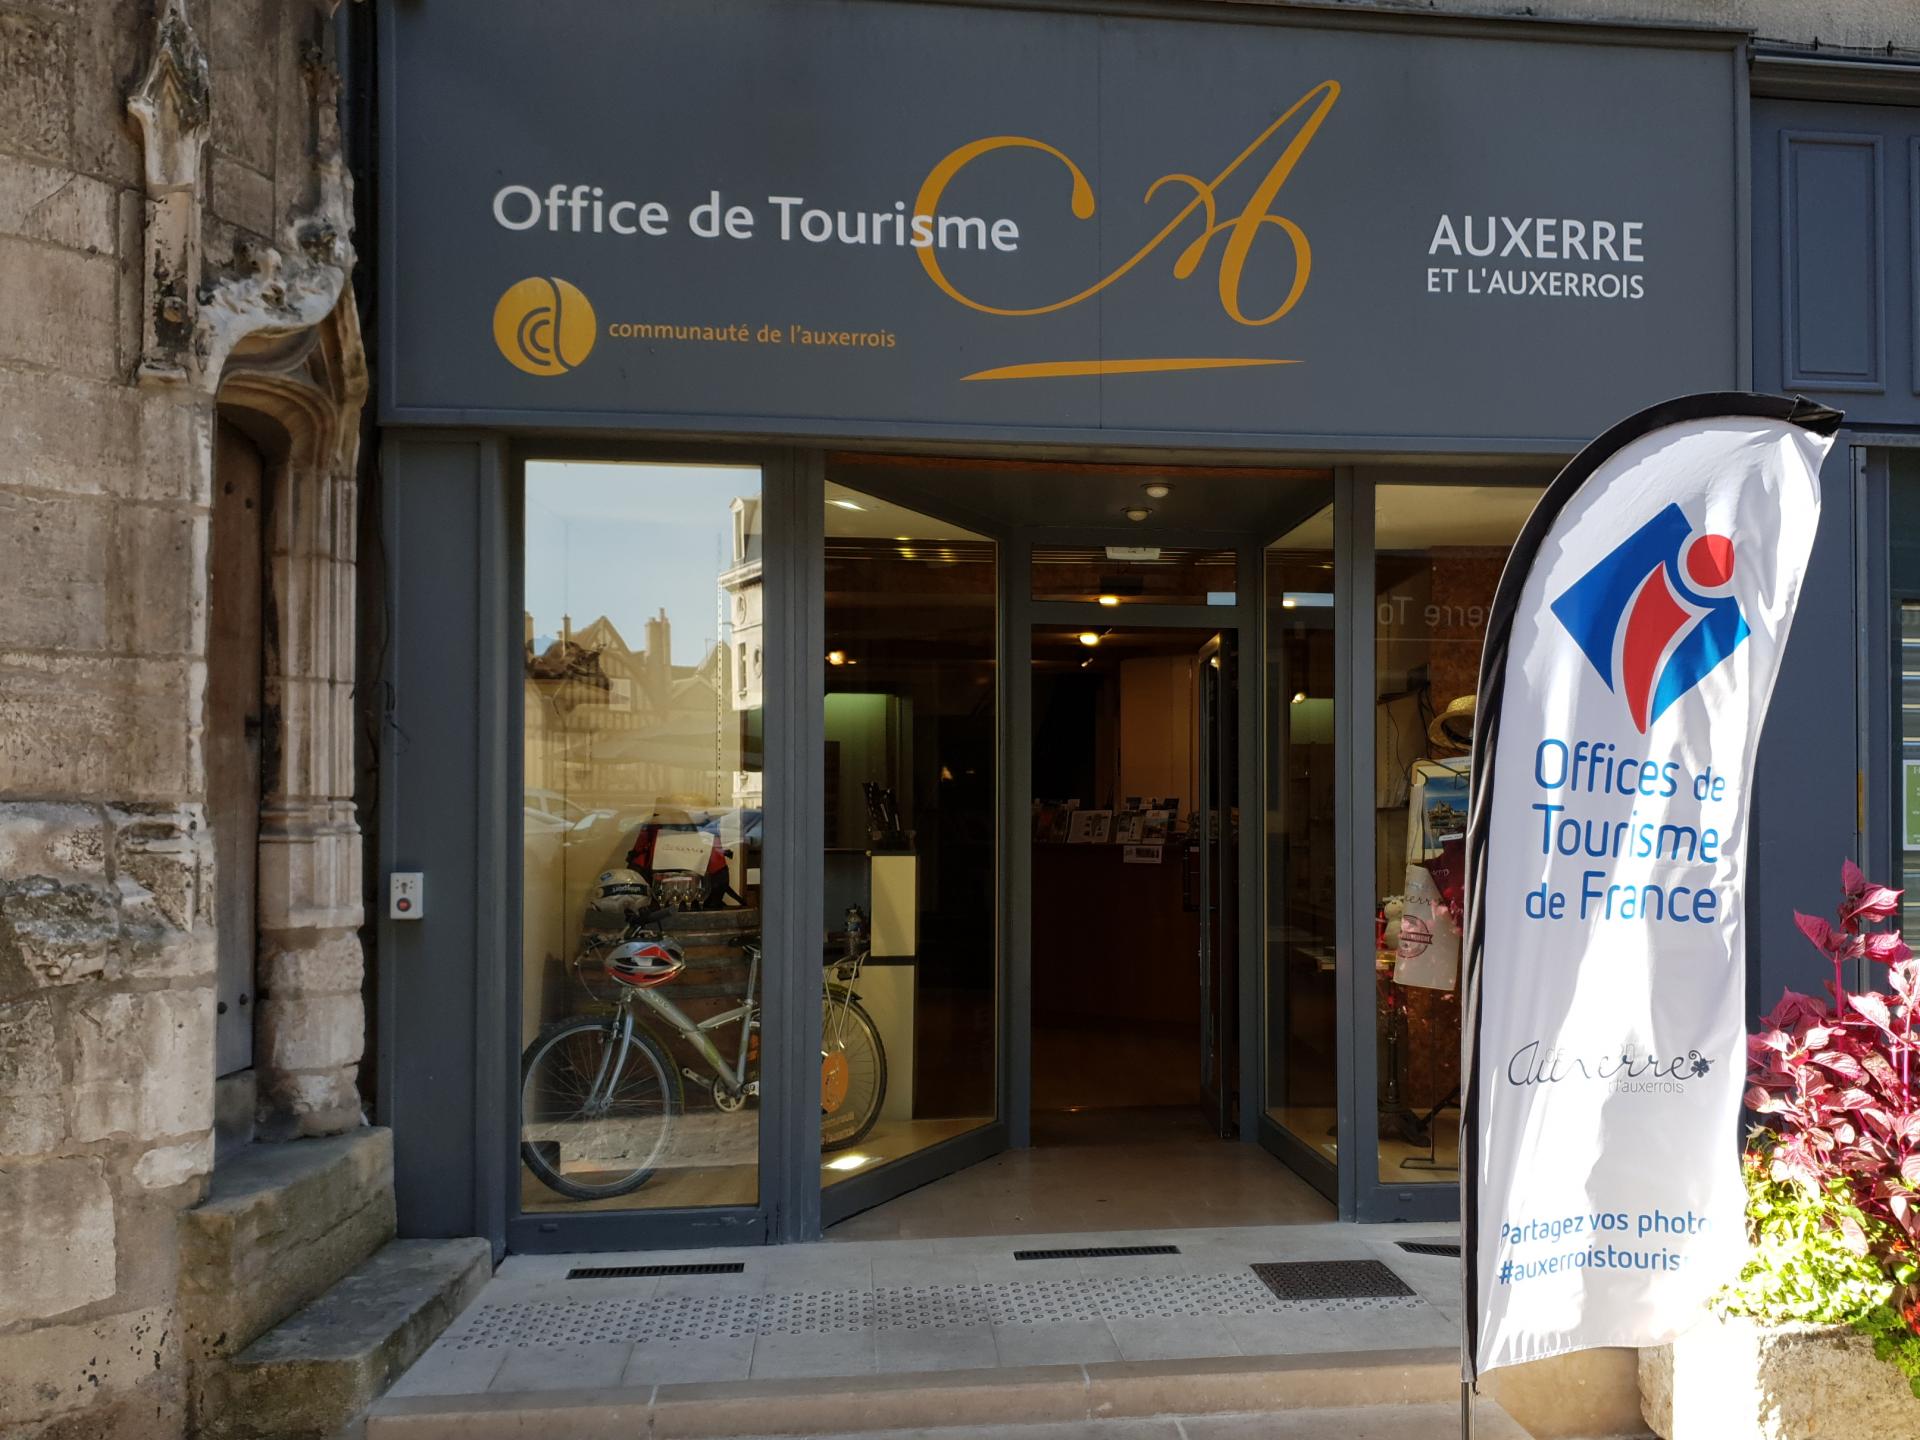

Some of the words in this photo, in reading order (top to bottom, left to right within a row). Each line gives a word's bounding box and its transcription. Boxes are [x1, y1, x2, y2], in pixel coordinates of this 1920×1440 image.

[493, 185, 669, 236] Office
[689, 191, 754, 239] de
[768, 196, 1019, 251] Tourisme
[1428, 214, 1644, 262] AUXERRE
[1427, 268, 1459, 293] ET
[1468, 267, 1645, 300] L'AUXERROIS
[608, 322, 749, 344] communauté
[757, 326, 781, 344] de
[790, 325, 896, 348] l'auxerrois
[1535, 738, 1680, 798] Offices
[1693, 766, 1726, 802] de
[1532, 803, 1719, 863] Tourisme
[1525, 882, 1565, 920] de
[1580, 871, 1717, 923] France
[1501, 1215, 1584, 1247] Partagez
[1589, 1212, 1629, 1231] vos
